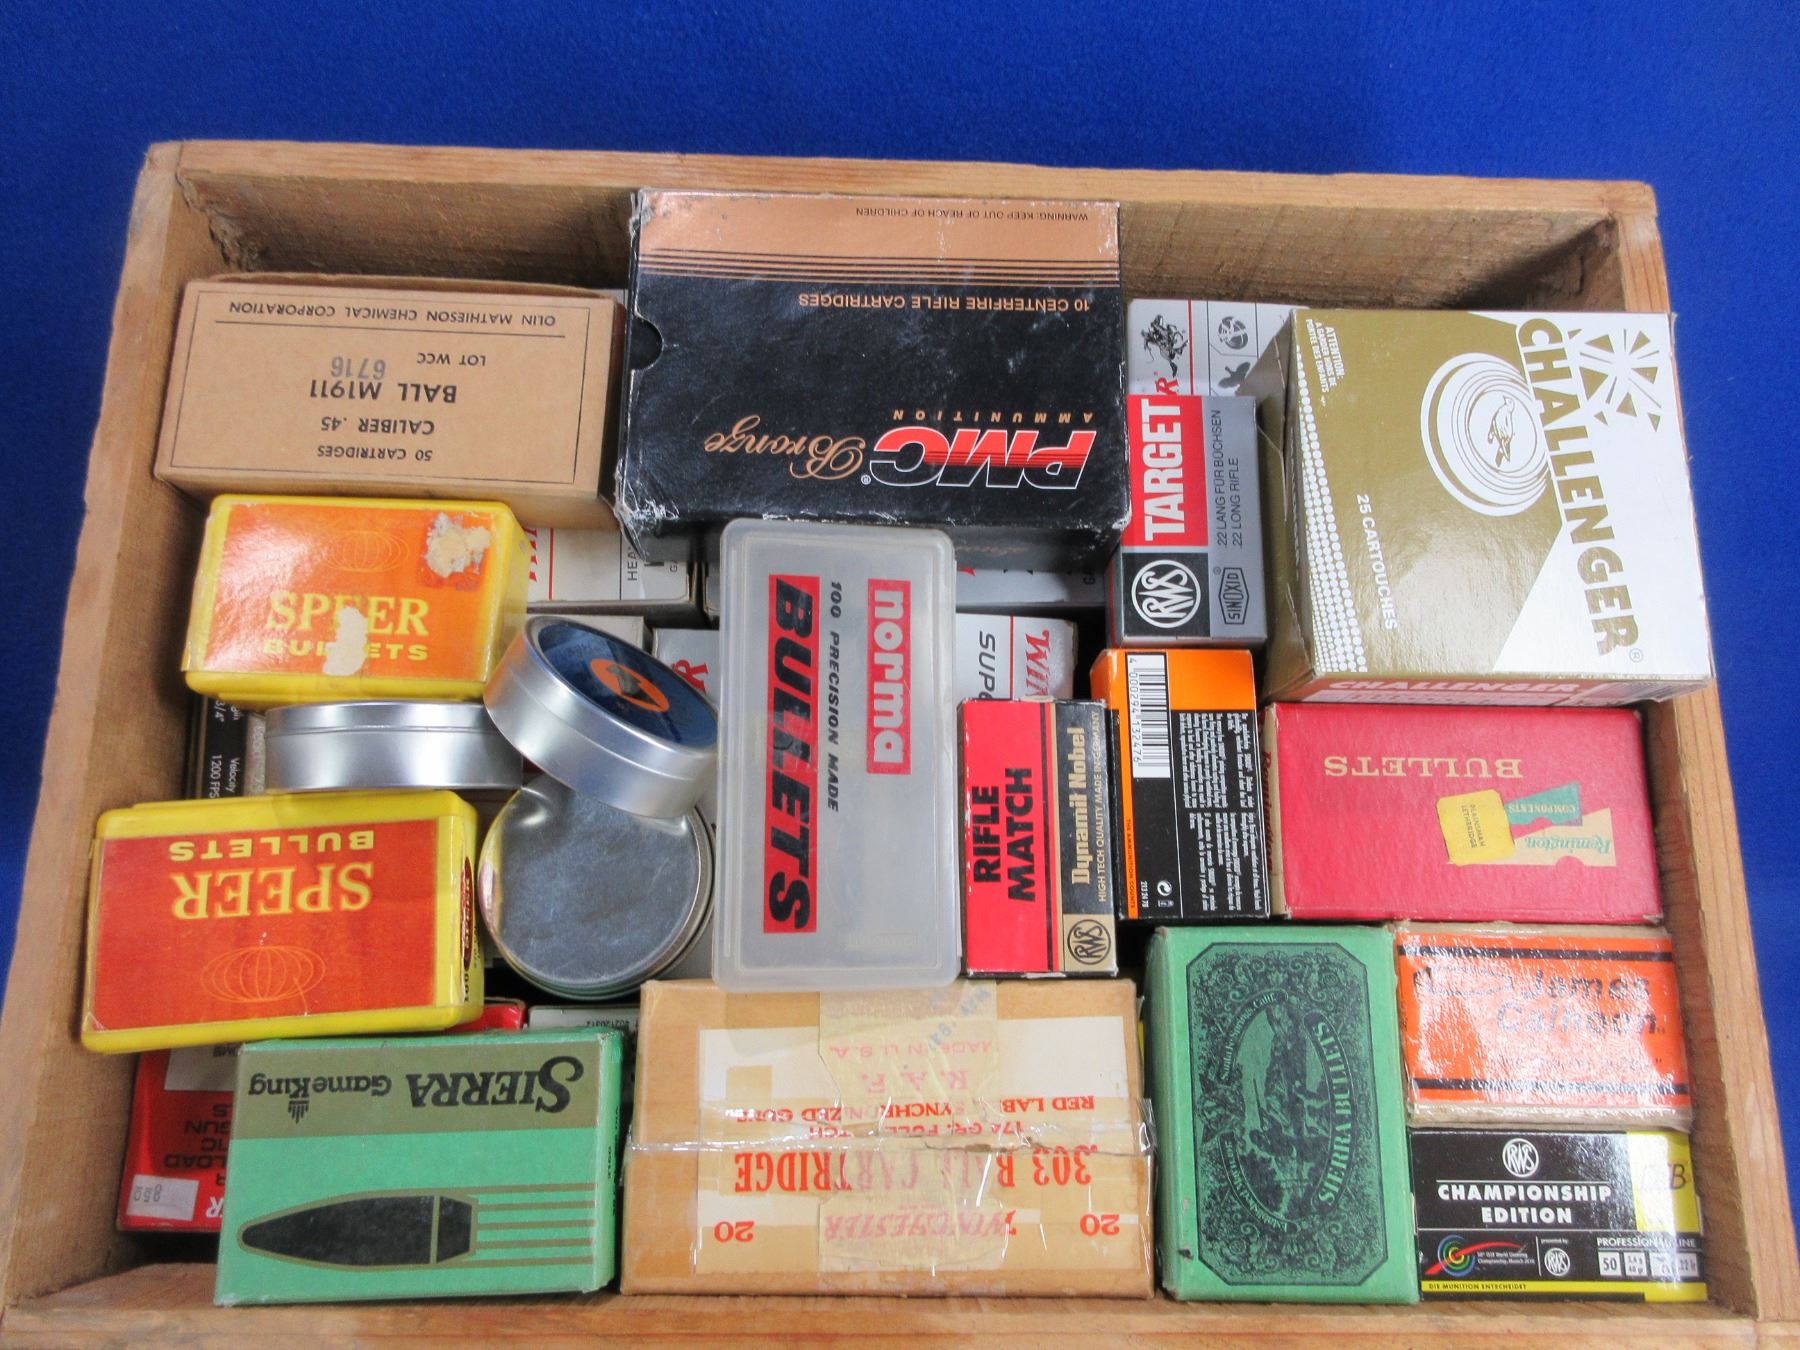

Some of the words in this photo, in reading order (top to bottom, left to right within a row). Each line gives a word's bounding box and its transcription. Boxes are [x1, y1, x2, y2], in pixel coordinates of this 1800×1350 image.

[856, 207, 908, 217] CHILDREN
[911, 208, 926, 217] OF
[928, 209, 963, 218] REACH
[965, 210, 980, 218] OF
[984, 211, 1004, 219] OUT
[1006, 212, 1034, 220] KEEP
[1039, 212, 1088, 221] WARNING:
[229, 300, 336, 317] CORPORATION
[345, 304, 417, 321] CHEMICAL
[798, 293, 905, 308] CARTRIDGES
[911, 295, 960, 309] RIFLE
[966, 297, 1069, 312] CENTERFIRE
[1074, 299, 1090, 312] 10
[426, 309, 512, 325] MATHIESON
[521, 313, 556, 327] OLIN
[330, 356, 387, 380] 6716
[416, 352, 451, 365] WCC
[459, 354, 487, 367] LOT
[309, 379, 382, 399] M1911
[398, 383, 457, 404] BALL
[320, 415, 348, 431] .45
[358, 417, 435, 435] CALIBER
[893, 410, 1093, 424] AMMUNITION
[317, 444, 407, 460] CARTRIDGES
[415, 449, 433, 462] 50
[704, 415, 866, 481] Bronze
[869, 426, 1097, 490] PMC
[1141, 398, 1185, 542] TARGET
[1229, 457, 1240, 492] RIFLE
[1517, 318, 1639, 657] CHALLENGER
[1215, 497, 1227, 530] LANG
[1230, 494, 1242, 530] LONG
[1357, 494, 1372, 514] 25
[1362, 517, 1398, 630] CARTOUCHES
[829, 580, 842, 618] 100
[1135, 565, 1197, 622] RWS
[1223, 572, 1244, 620] SINOXID
[264, 640, 428, 662] BULETS
[828, 630, 840, 744] PRECISION
[873, 590, 905, 764] norma
[1328, 680, 1581, 693] CHALLENGER
[1129, 672, 1139, 713] 000294
[768, 577, 814, 931] BULLETS
[1132, 721, 1142, 763] 132476
[210, 755, 222, 780] 1200
[1066, 727, 1087, 789] Nobel
[1323, 755, 1524, 779] BULLETS
[225, 757, 240, 793] Velocity
[827, 752, 839, 813] MADE
[1093, 776, 1103, 803] MADE
[1507, 802, 1577, 814] COMPONENTS
[971, 785, 1001, 883] RIFLE
[1005, 767, 1036, 903] MATCH
[1069, 792, 1093, 885] Dynamit
[1094, 806, 1105, 847] QUALITY
[169, 830, 375, 862] BULLETS
[1096, 857, 1106, 880] TECH
[170, 862, 374, 920] SPEER
[1098, 882, 1107, 902] HIGH
[1521, 969, 1650, 1000] James
[1314, 1021, 1351, 1117] BULLETS
[249, 1073, 393, 1099] GameKing
[406, 1055, 585, 1114] SIERRA
[801, 1102, 966, 1122] SYNCHRNZED
[1052, 1095, 1096, 1111] RED
[1317, 1123, 1351, 1203] SIERRA
[1504, 1140, 1538, 1177] RWS
[734, 1151, 920, 1192] CARTRIDGE
[1437, 1184, 1612, 1201] CHAMPIONSHIP
[1078, 1213, 1121, 1237] 20
[1481, 1206, 1573, 1224] EDITION
[713, 1219, 755, 1243] 20
[1602, 1257, 1618, 1271] 50
